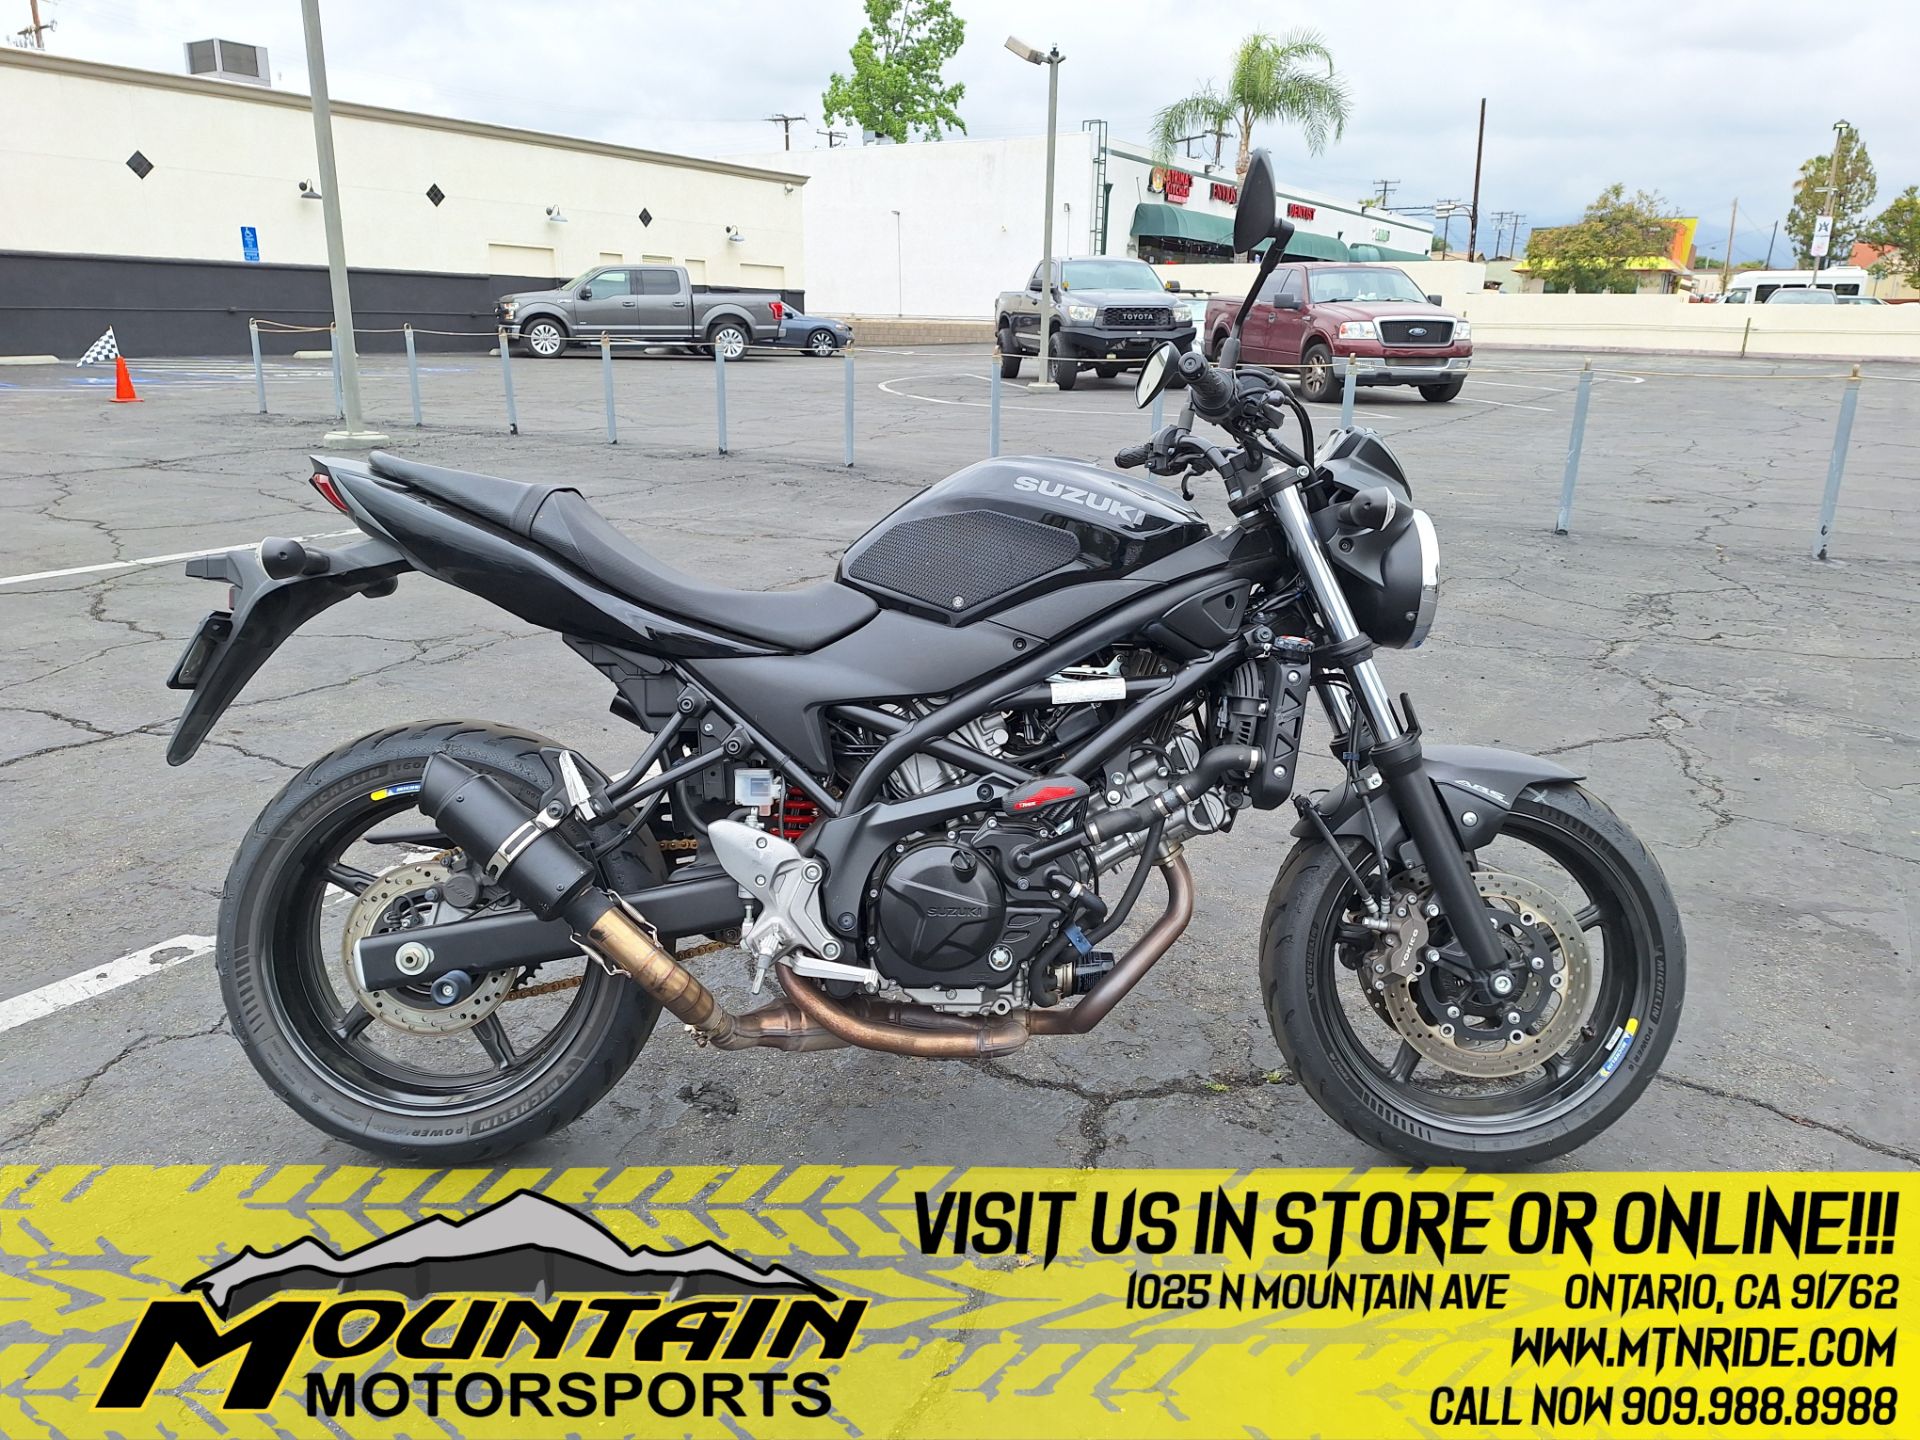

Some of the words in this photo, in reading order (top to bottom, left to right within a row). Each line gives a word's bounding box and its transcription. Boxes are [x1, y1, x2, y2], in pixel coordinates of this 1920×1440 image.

[1288, 203, 1316, 220] DENTIST
[1013, 476, 1147, 528] SUZUKI
[300, 767, 381, 820] MICHELIN
[927, 906, 982, 918] SUZUKI
[1400, 928, 1419, 968] TOKICO
[1651, 961, 1665, 1020] MICHELIN
[1633, 1027, 1654, 1064] POWER
[479, 1079, 560, 1132] MICHELIN
[411, 1126, 464, 1138] POWER
